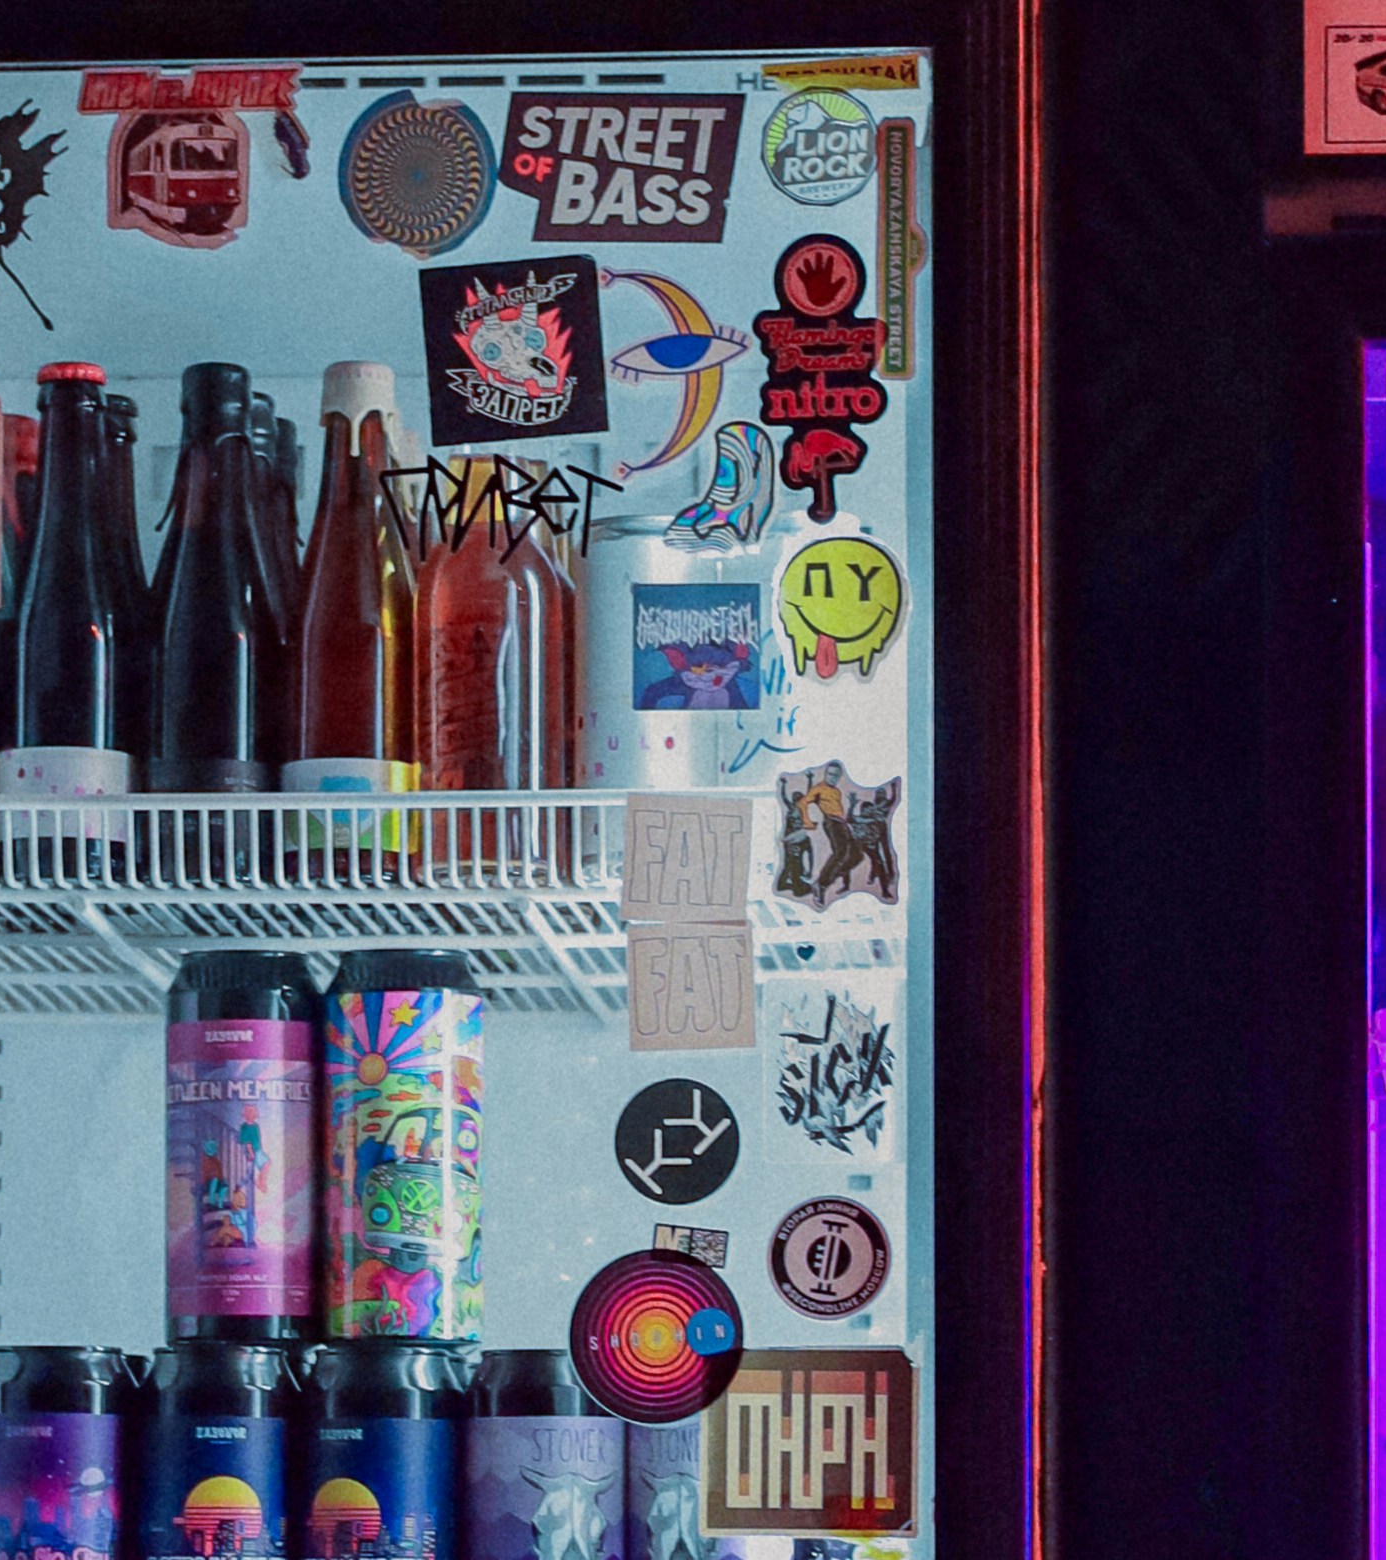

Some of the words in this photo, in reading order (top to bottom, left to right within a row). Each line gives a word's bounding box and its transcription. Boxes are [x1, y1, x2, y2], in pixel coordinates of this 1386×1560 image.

[518, 104, 726, 175] STREET
[794, 128, 870, 154] LION
[513, 153, 554, 184] OF
[782, 151, 868, 180] ROCK
[550, 160, 715, 227] BASS
[761, 317, 877, 347] Flamingo
[889, 303, 903, 367] STREET
[475, 384, 564, 421] ЗАПРЕТ
[767, 372, 882, 419] nitro
[627, 809, 746, 908] FAT
[631, 932, 749, 1037] FAT
[226, 1080, 312, 1103] MEMORIES
[777, 1205, 816, 1243] ВТОРАЯ
[816, 1202, 861, 1219] ЛИНИЯ
